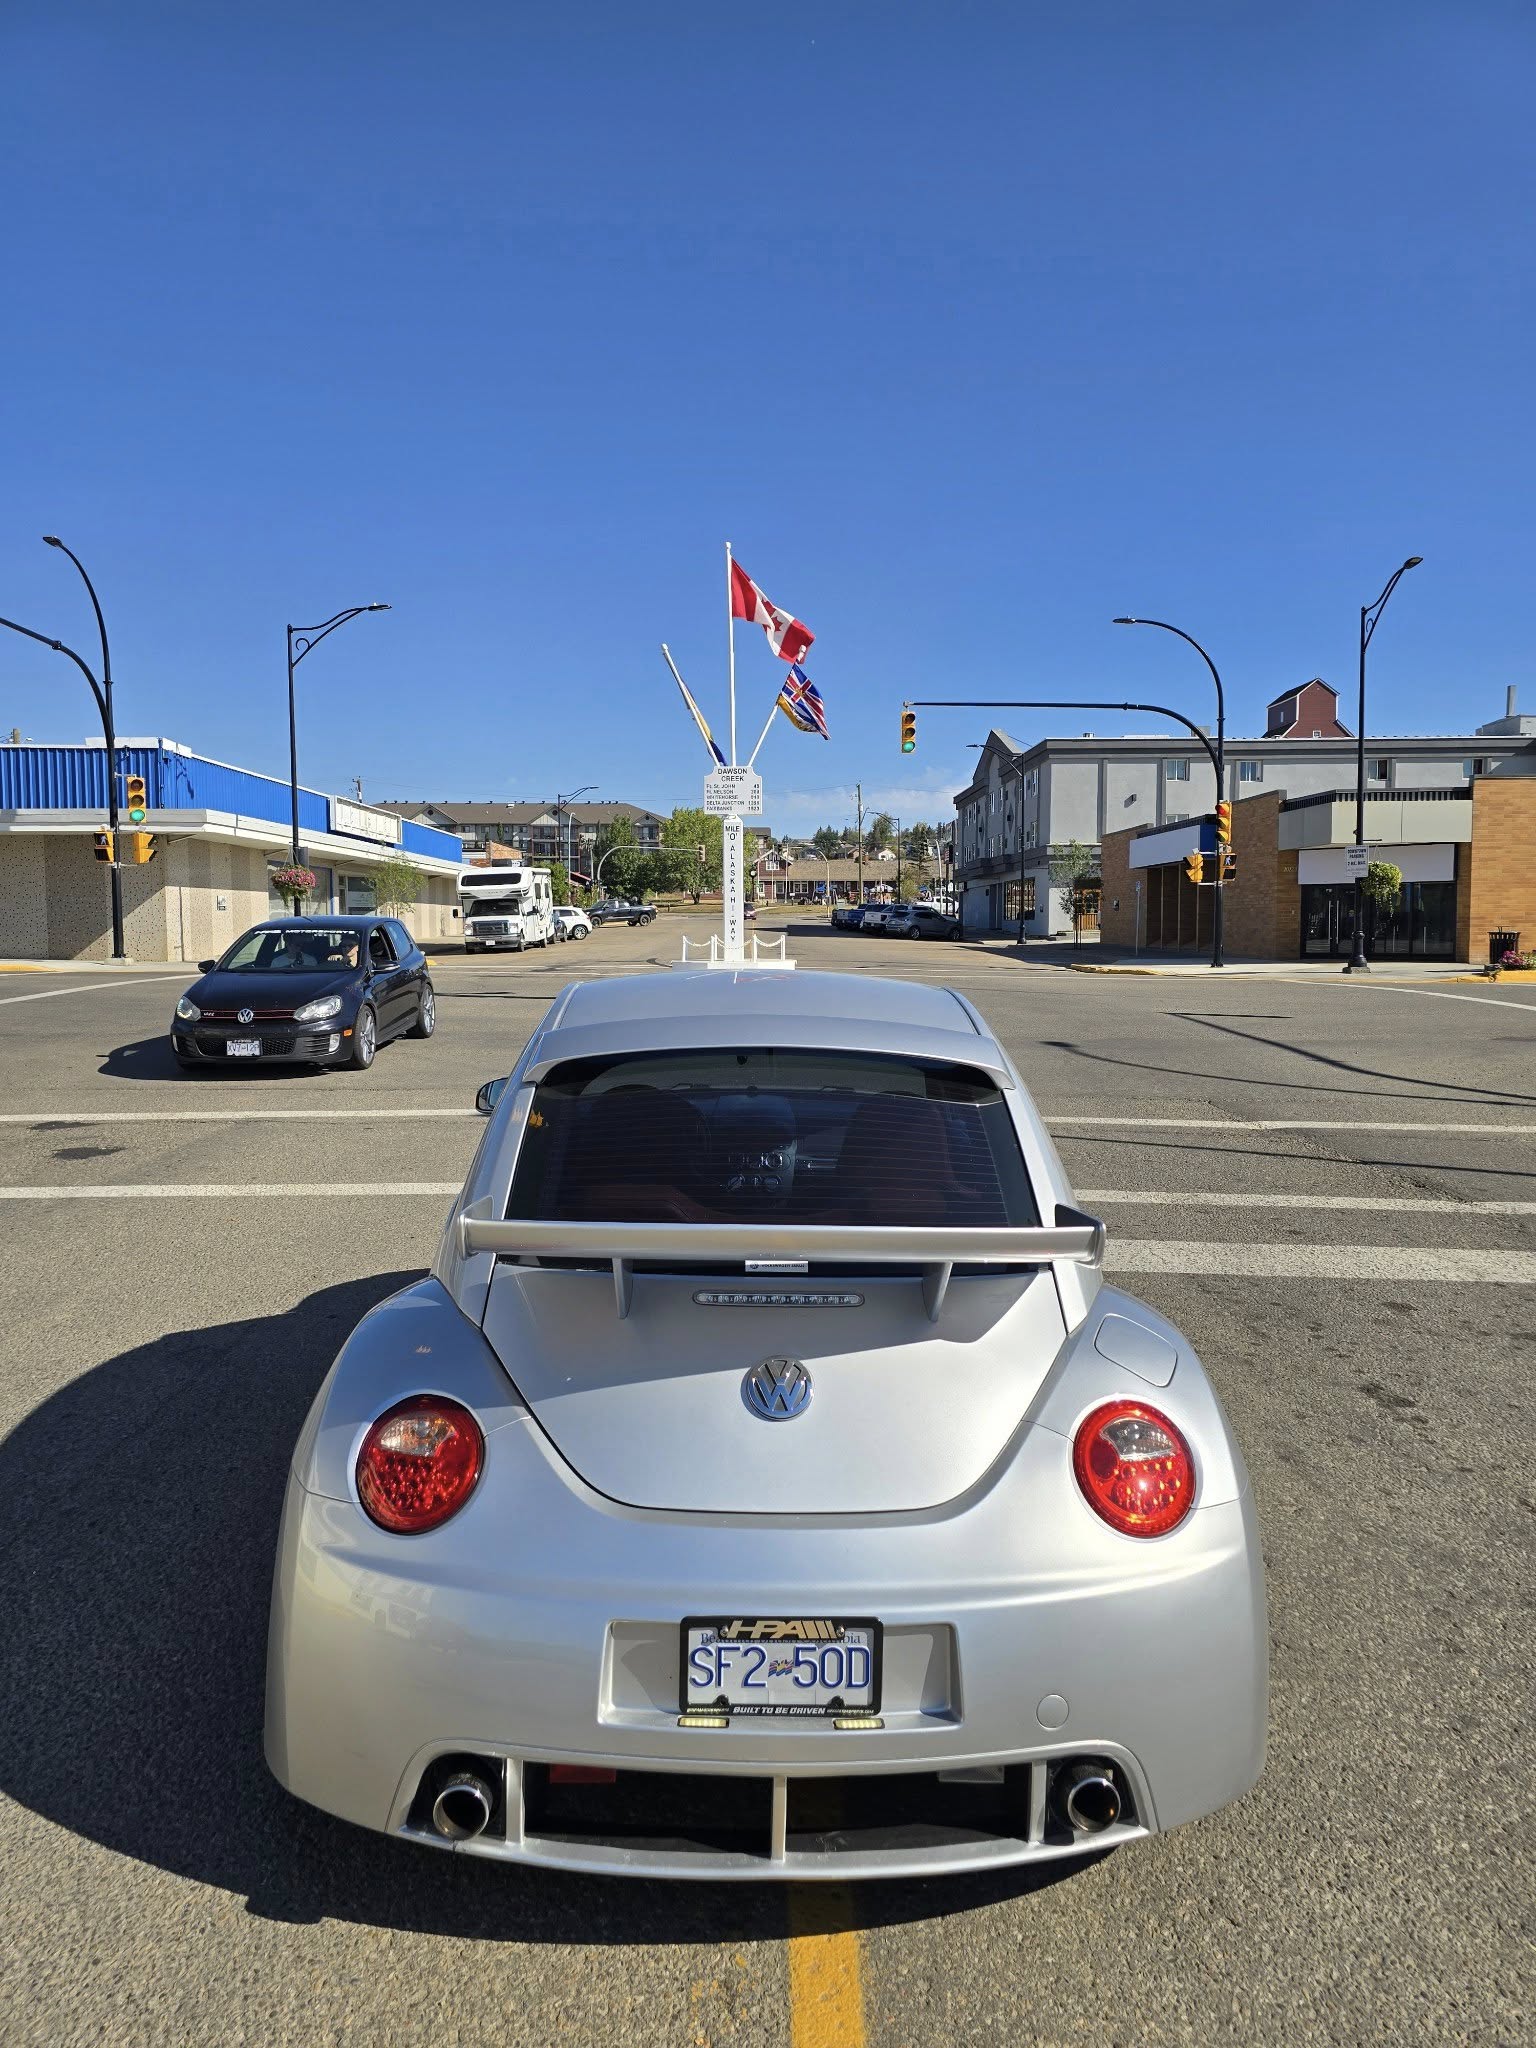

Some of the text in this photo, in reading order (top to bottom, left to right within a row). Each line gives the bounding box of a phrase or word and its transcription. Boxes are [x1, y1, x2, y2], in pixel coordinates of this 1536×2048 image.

[747, 1356, 813, 1419] VW
[689, 1645, 768, 1688] SF2
[732, 1706, 759, 1714] BUILT
[761, 1706, 774, 1714] TO
[774, 1706, 788, 1714] BE
[789, 1706, 826, 1714] DRIVEN
